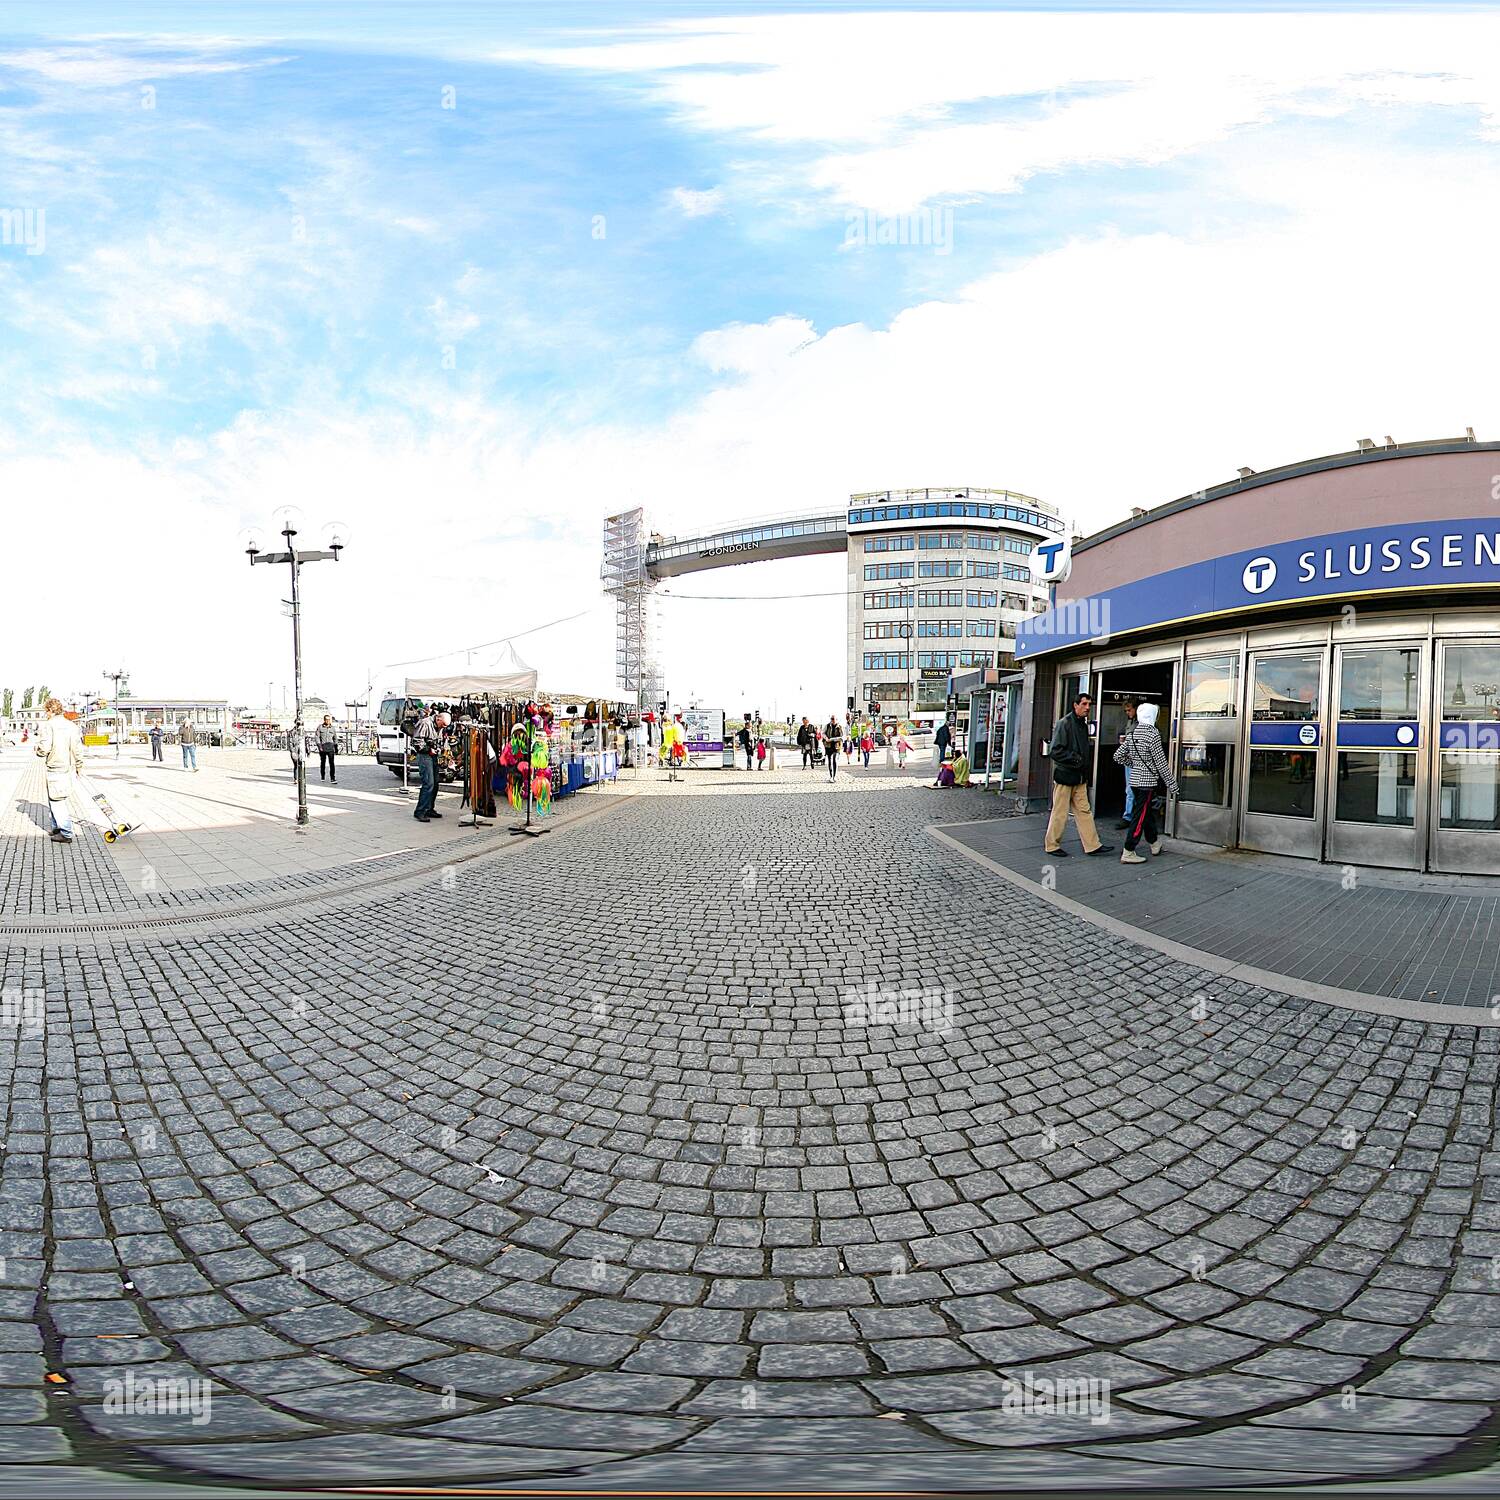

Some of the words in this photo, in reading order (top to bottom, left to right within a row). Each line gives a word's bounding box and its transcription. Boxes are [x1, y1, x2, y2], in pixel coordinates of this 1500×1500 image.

[708, 541, 759, 556] GONDOLEN
[1038, 542, 1064, 573] T
[1249, 563, 1269, 589] T
